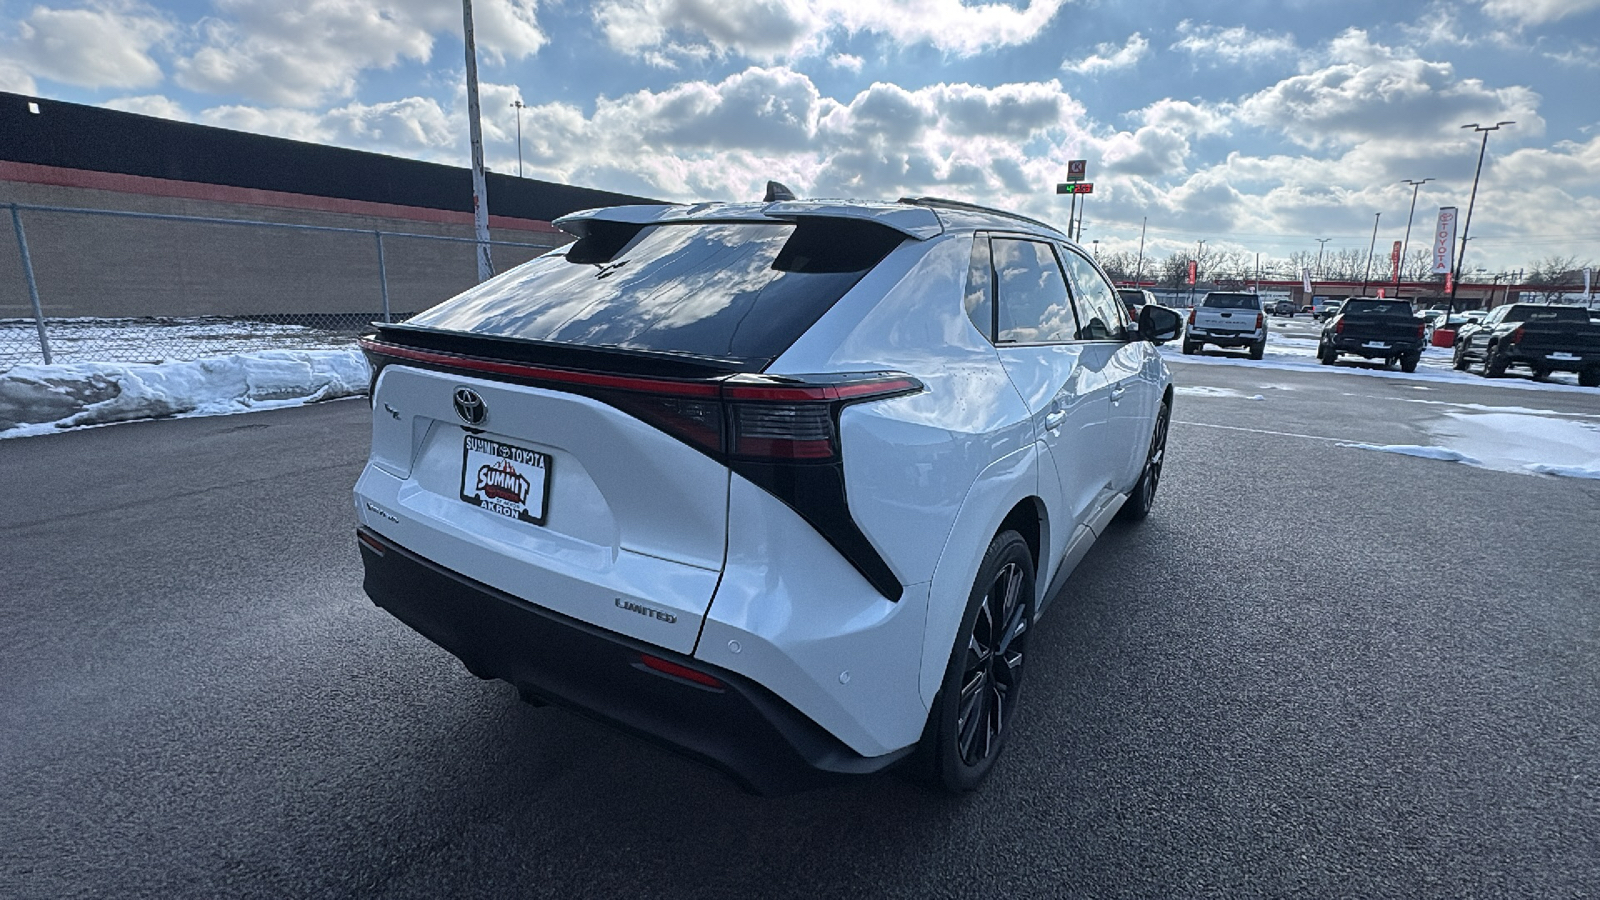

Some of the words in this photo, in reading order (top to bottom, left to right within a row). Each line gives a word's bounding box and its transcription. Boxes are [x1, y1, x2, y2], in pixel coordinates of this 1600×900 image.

[1436, 222, 1449, 269] TOYOTA
[466, 437, 499, 456] SUMMIT
[511, 448, 545, 468] TOYOTA
[477, 466, 529, 501] SUMMIT
[481, 500, 519, 519] AKRON
[614, 597, 678, 623] LIMITED
